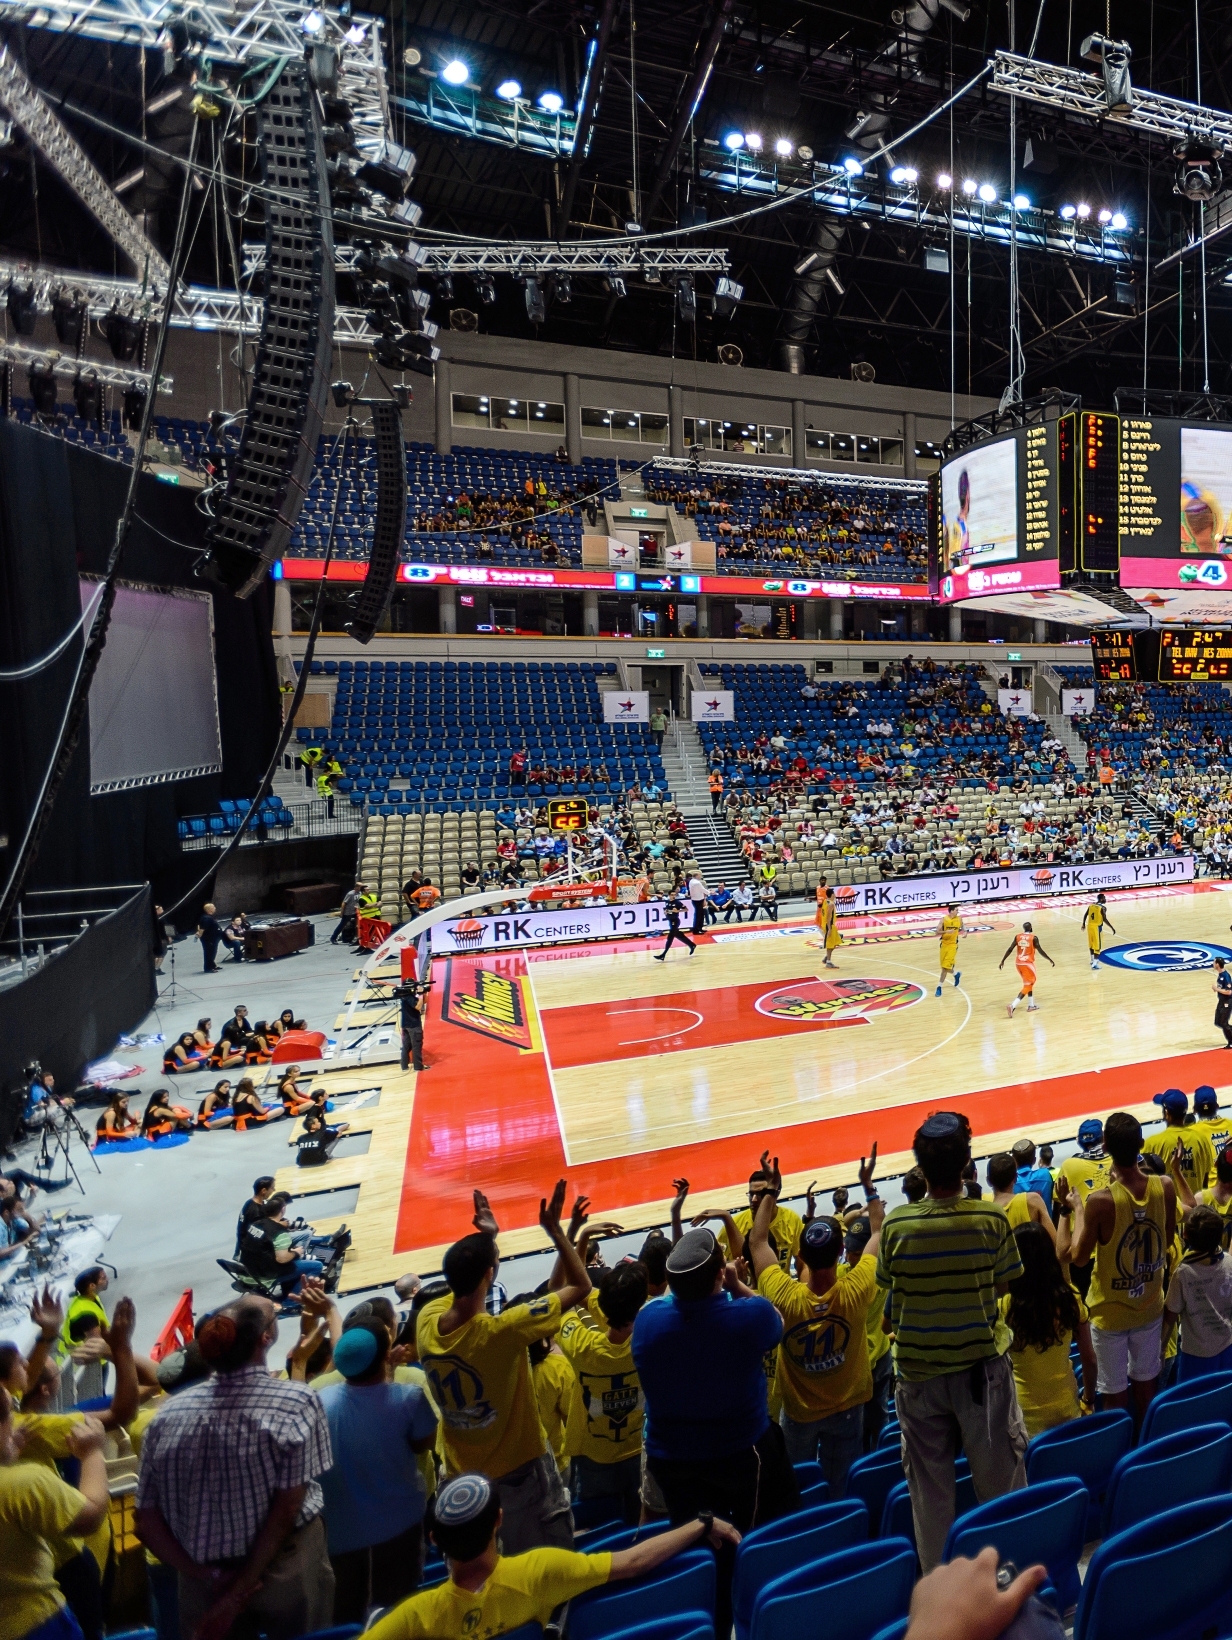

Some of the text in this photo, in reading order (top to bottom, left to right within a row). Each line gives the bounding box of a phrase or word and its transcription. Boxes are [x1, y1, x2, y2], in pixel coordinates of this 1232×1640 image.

[1060, 870, 1122, 888] RK CENTERS
[1134, 861, 1185, 881] רענן כץ
[864, 886, 936, 906] RK CENTERS
[950, 876, 1010, 898] רענן כץ
[494, 918, 590, 942] RK CENTERS
[609, 909, 636, 931] כץ
[768, 982, 911, 1017] Winner
[797, 1324, 835, 1362] 11
[805, 1352, 846, 1372] ARMY
[604, 1390, 637, 1402] GATE
